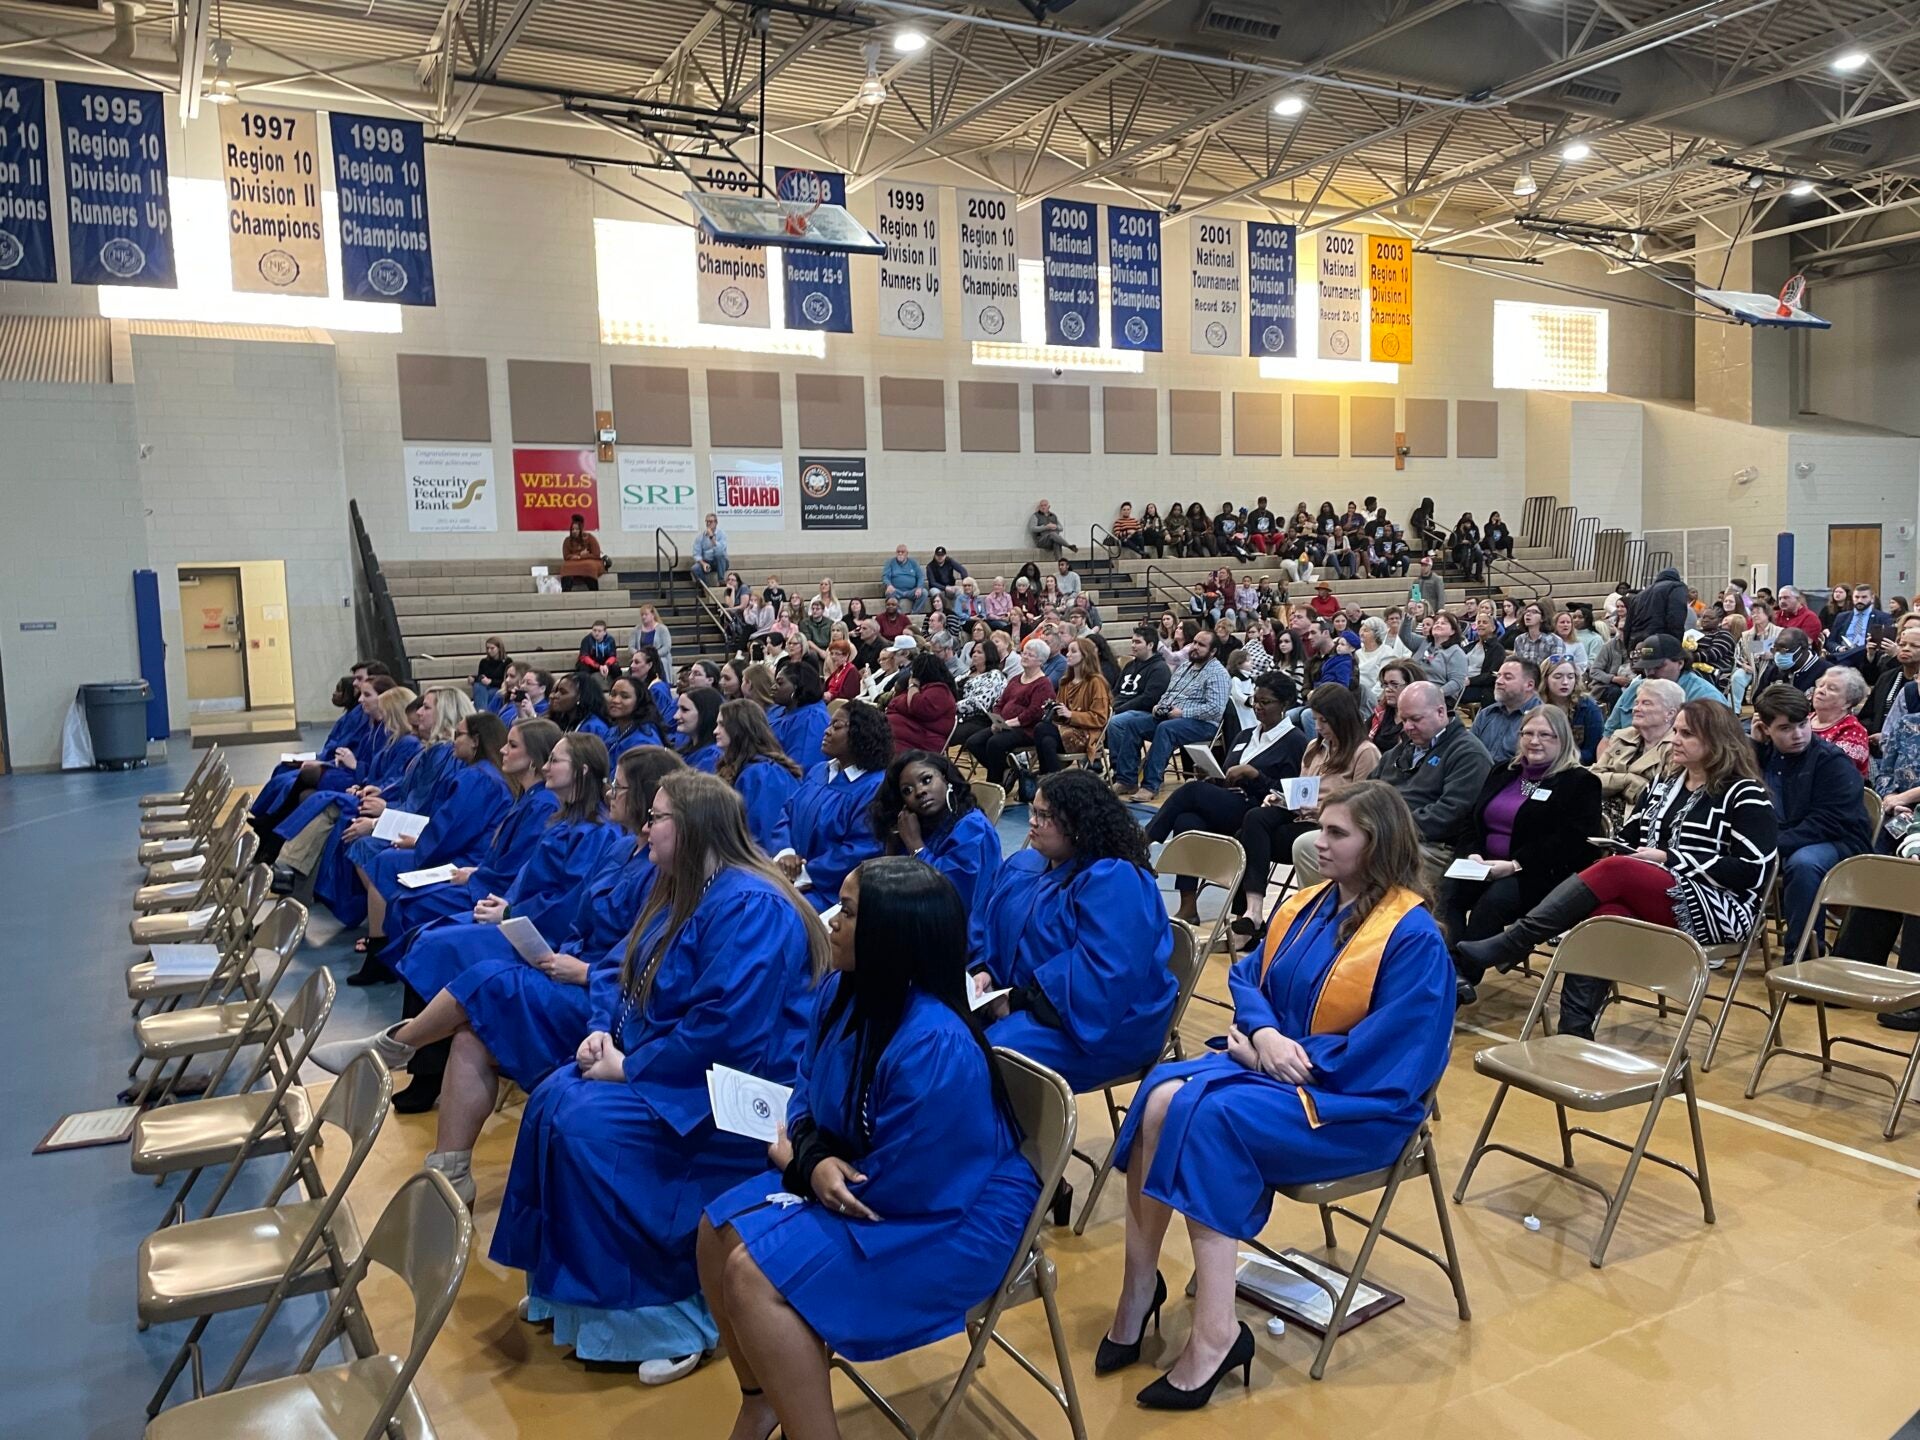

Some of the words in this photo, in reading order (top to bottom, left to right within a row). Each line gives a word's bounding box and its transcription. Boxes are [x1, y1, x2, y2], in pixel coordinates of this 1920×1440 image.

[81, 94, 143, 126] 1995
[18, 121, 39, 150] 10
[241, 112, 296, 141] 1997
[350, 123, 405, 154] 1998
[68, 127, 130, 161] Region
[139, 133, 160, 162] 10
[227, 143, 284, 175] Region
[294, 150, 312, 175] 10
[338, 154, 394, 187] Region
[401, 160, 419, 188] 10
[29, 159, 42, 186] II
[70, 162, 142, 194] Division
[150, 169, 163, 196] II
[230, 176, 296, 205] Division
[304, 183, 315, 207] II
[790, 176, 832, 202] 1998
[887, 188, 924, 212] 1999
[71, 196, 138, 227] Runners
[146, 201, 167, 235] Up
[341, 187, 404, 218] Division
[411, 194, 423, 220] II
[968, 198, 1006, 221] 2000
[230, 209, 321, 242] Champions
[880, 214, 917, 240] Region
[923, 219, 935, 240] 10
[1051, 206, 1088, 230] 2000
[1119, 214, 1153, 238] 2001
[341, 219, 428, 253] Champions
[961, 223, 997, 248] Region
[1002, 227, 1014, 247] 10
[1049, 231, 1092, 255] National
[1200, 224, 1231, 245] 2001
[1256, 228, 1288, 249] 2002
[1326, 236, 1354, 255] 2002
[882, 241, 924, 265] Division
[929, 247, 937, 266] II
[963, 249, 1003, 271] Division
[1008, 253, 1015, 272] II
[1111, 238, 1143, 263] Region
[1147, 242, 1158, 262] 10
[1196, 247, 1234, 268] National
[1250, 251, 1284, 272] District
[1287, 255, 1293, 272] 7
[1377, 243, 1404, 261] 2003
[698, 252, 766, 280] Champions
[787, 265, 819, 282] Record
[822, 268, 843, 285] 25-9
[1044, 256, 1098, 280] Tournament
[1111, 263, 1148, 286] Division
[1151, 267, 1159, 286] II
[1323, 258, 1357, 278] National
[1371, 264, 1397, 284] Region
[1401, 267, 1408, 283] 10
[881, 268, 921, 292] Runners
[926, 273, 939, 297] Up
[962, 274, 1018, 300] Champions
[1192, 270, 1239, 292] Tournament
[1250, 274, 1284, 295] Division
[1287, 278, 1294, 296] II
[1319, 281, 1360, 301] Tournament
[1049, 286, 1075, 303] Record
[1111, 286, 1160, 312] Champions
[1194, 298, 1218, 312] Record
[1372, 286, 1402, 304] Division
[1250, 298, 1296, 322] Champions
[1320, 308, 1340, 321] Record
[1370, 307, 1411, 328] Champions
[412, 475, 469, 489] Security
[520, 473, 592, 488] WELLS
[727, 475, 766, 486] NATIONAL
[414, 487, 463, 499] Federal
[415, 499, 451, 510] Bank
[523, 492, 593, 508] FARGO
[623, 484, 695, 505] SRP
[728, 486, 780, 507] GUARD
